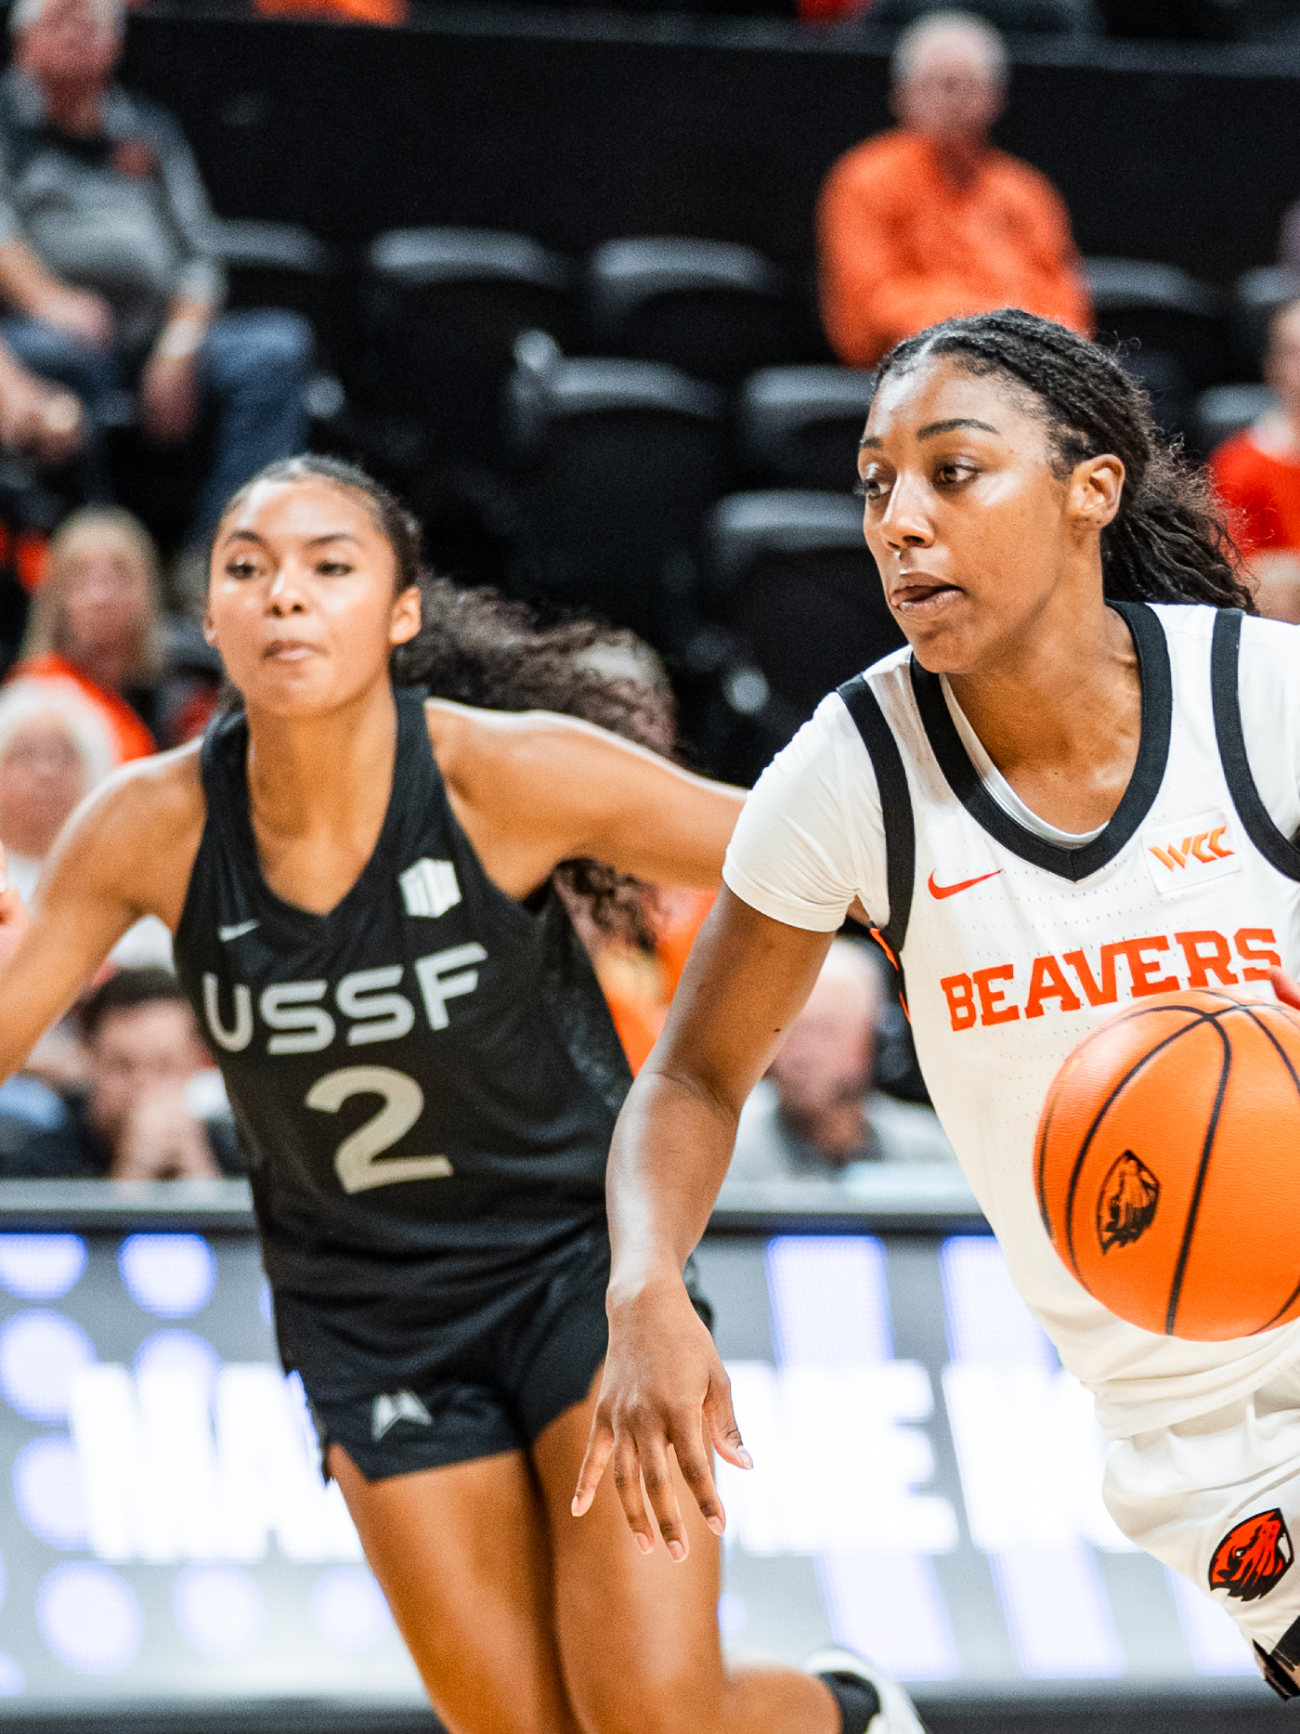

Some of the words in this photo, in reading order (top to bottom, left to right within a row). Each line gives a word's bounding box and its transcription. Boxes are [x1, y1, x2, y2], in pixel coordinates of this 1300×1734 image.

[1148, 825, 1235, 872] WCC
[203, 942, 488, 1055] USSF
[940, 928, 1282, 1032] BEAVERS
[305, 1065, 453, 1195] 2
